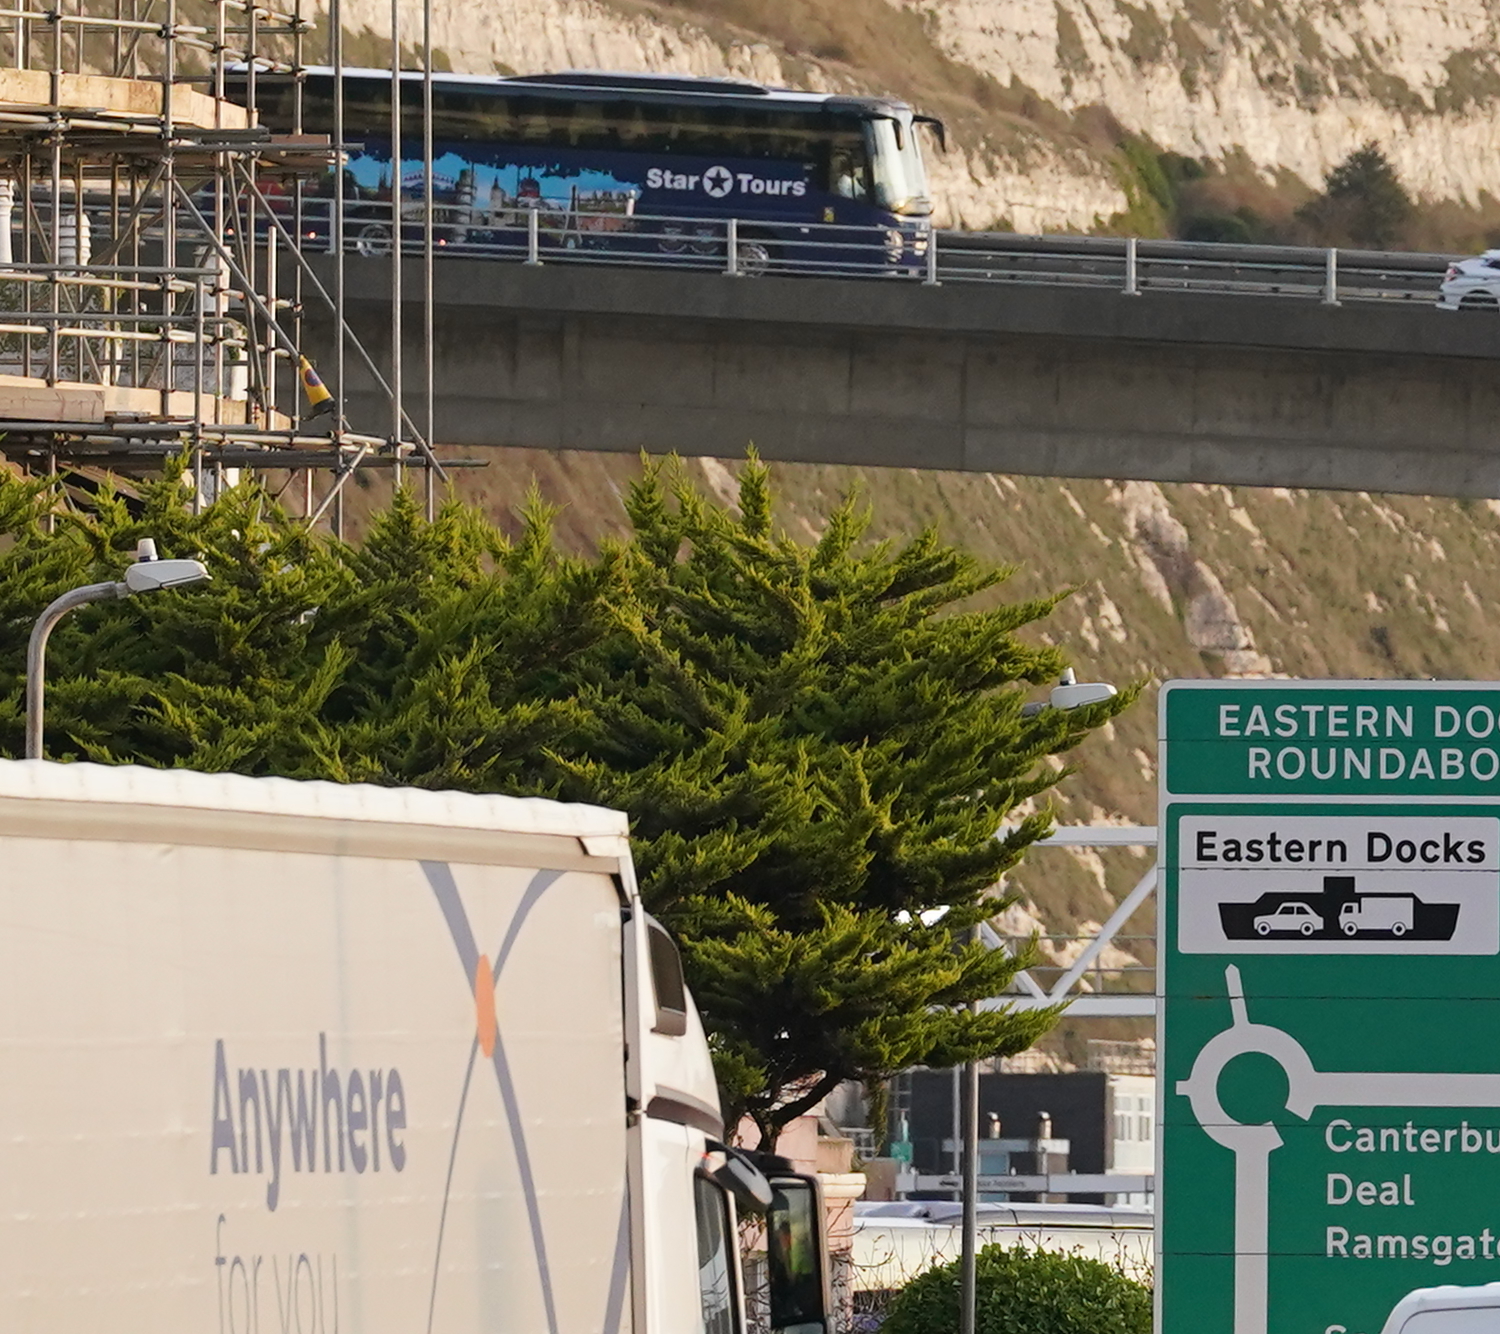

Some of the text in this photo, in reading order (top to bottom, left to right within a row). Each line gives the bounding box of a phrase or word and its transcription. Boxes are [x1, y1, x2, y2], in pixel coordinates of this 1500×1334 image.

[646, 168, 806, 196] Star Tours
[1218, 704, 1414, 738] EASTERN
[1195, 831, 1486, 864] Eastern Docks
[210, 1031, 407, 1212] Anywhere
[1326, 1174, 1415, 1205] Deal
